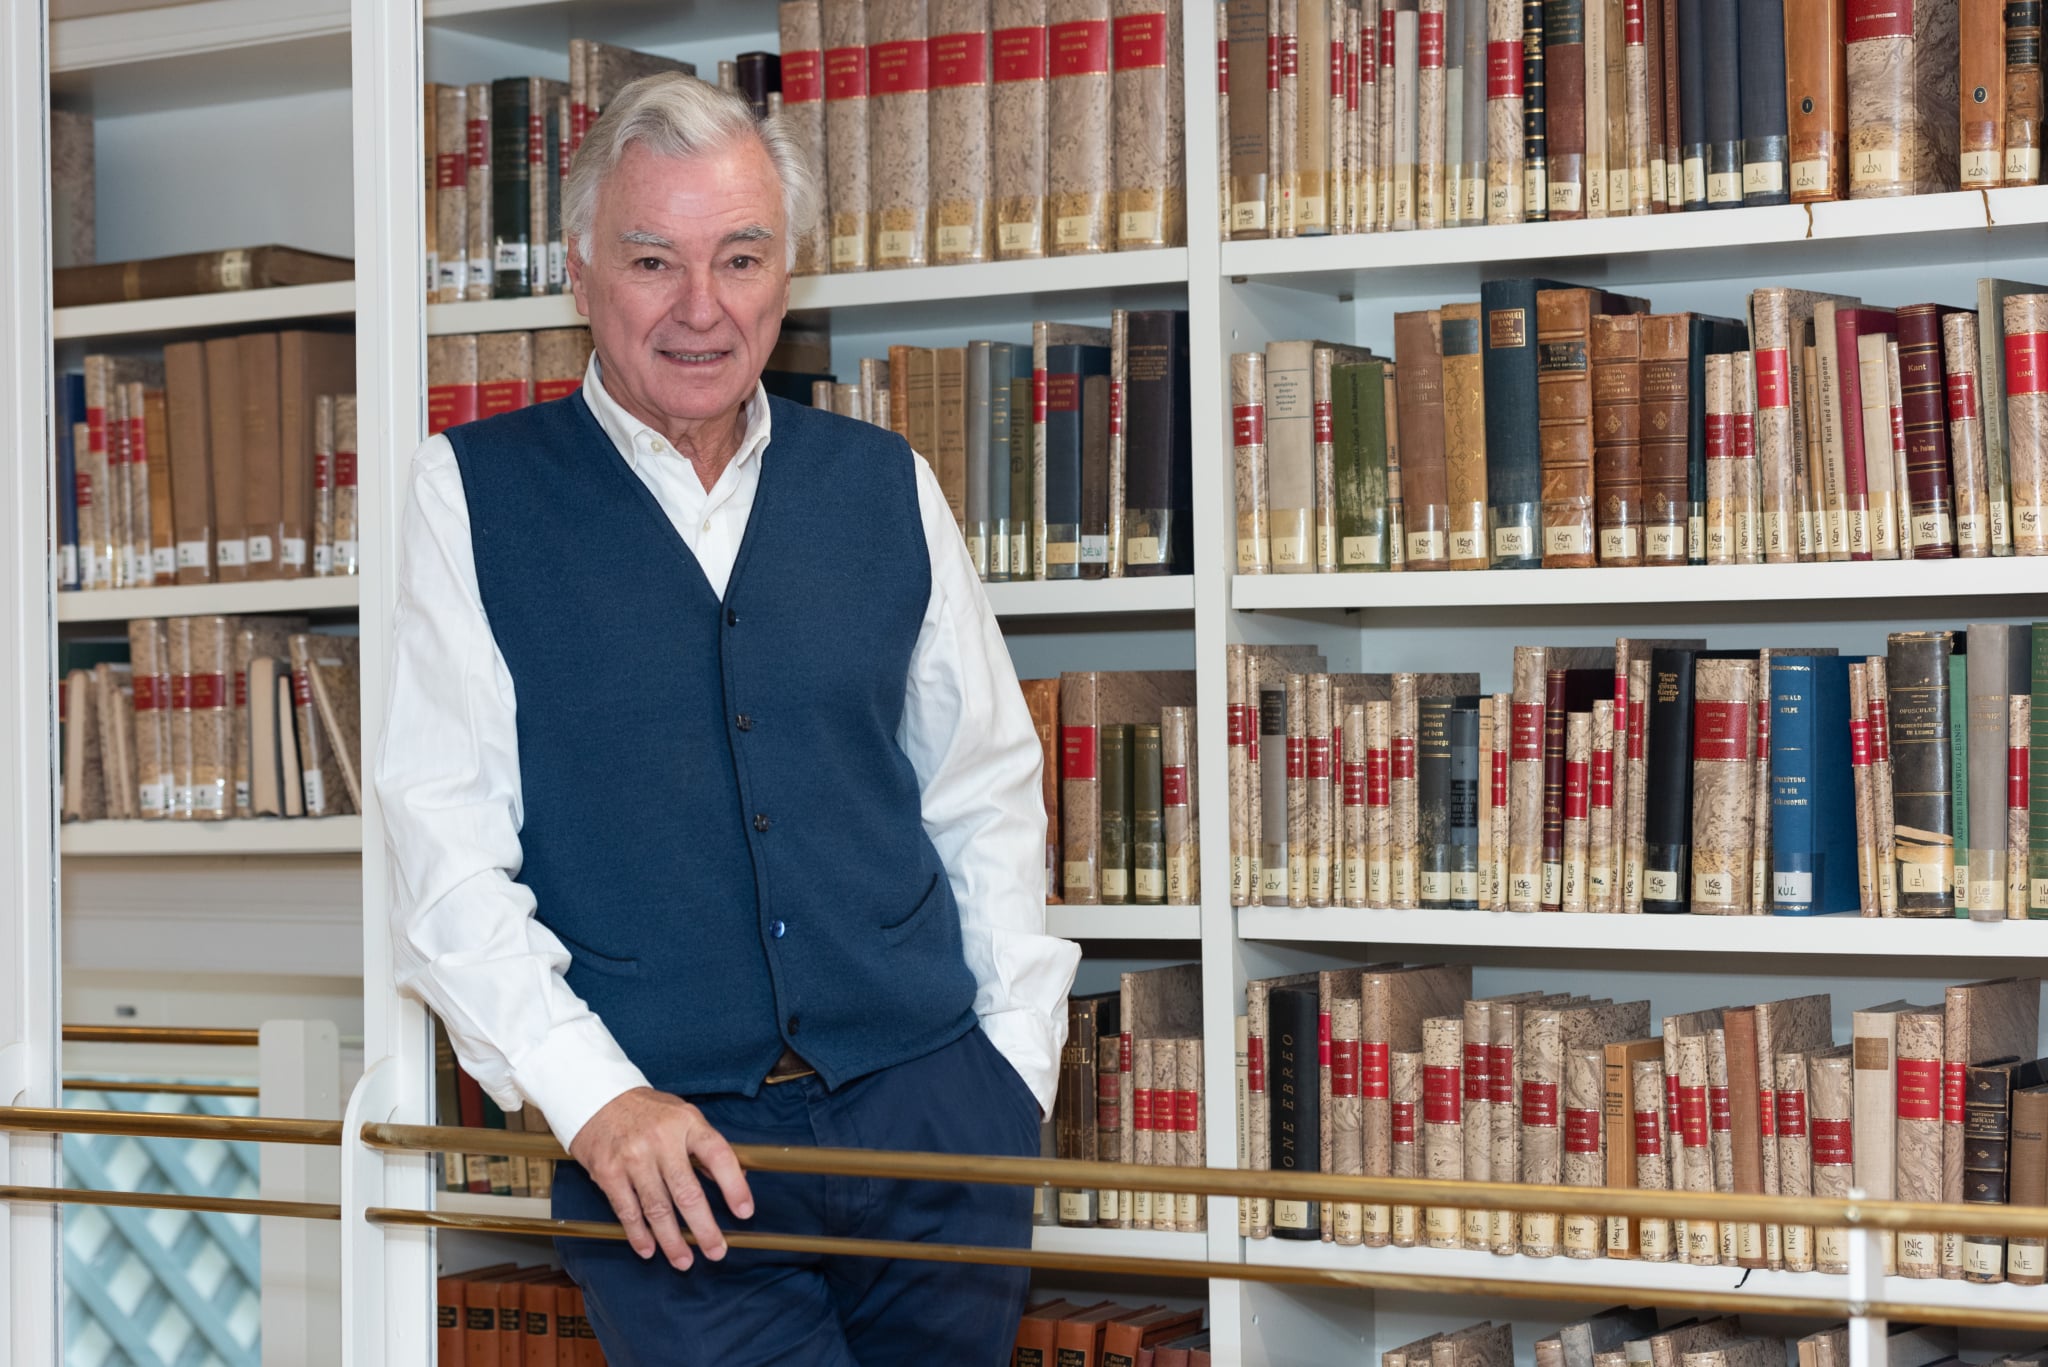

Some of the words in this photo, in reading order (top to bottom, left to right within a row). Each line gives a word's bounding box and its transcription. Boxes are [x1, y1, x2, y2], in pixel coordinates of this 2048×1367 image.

[1822, 355, 1831, 393] Epigonen
[1908, 363, 1927, 373] Kant
[1823, 393, 1831, 407] die
[1824, 424, 1833, 443] Kant
[1827, 456, 1836, 494] Liebmann
[1777, 886, 1797, 896] KUL
[1062, 1046, 1089, 1064] EGEL
[1281, 1033, 1295, 1112] EBREO
[1968, 1259, 1989, 1271] NIE
[2013, 1260, 2033, 1271] NIE
